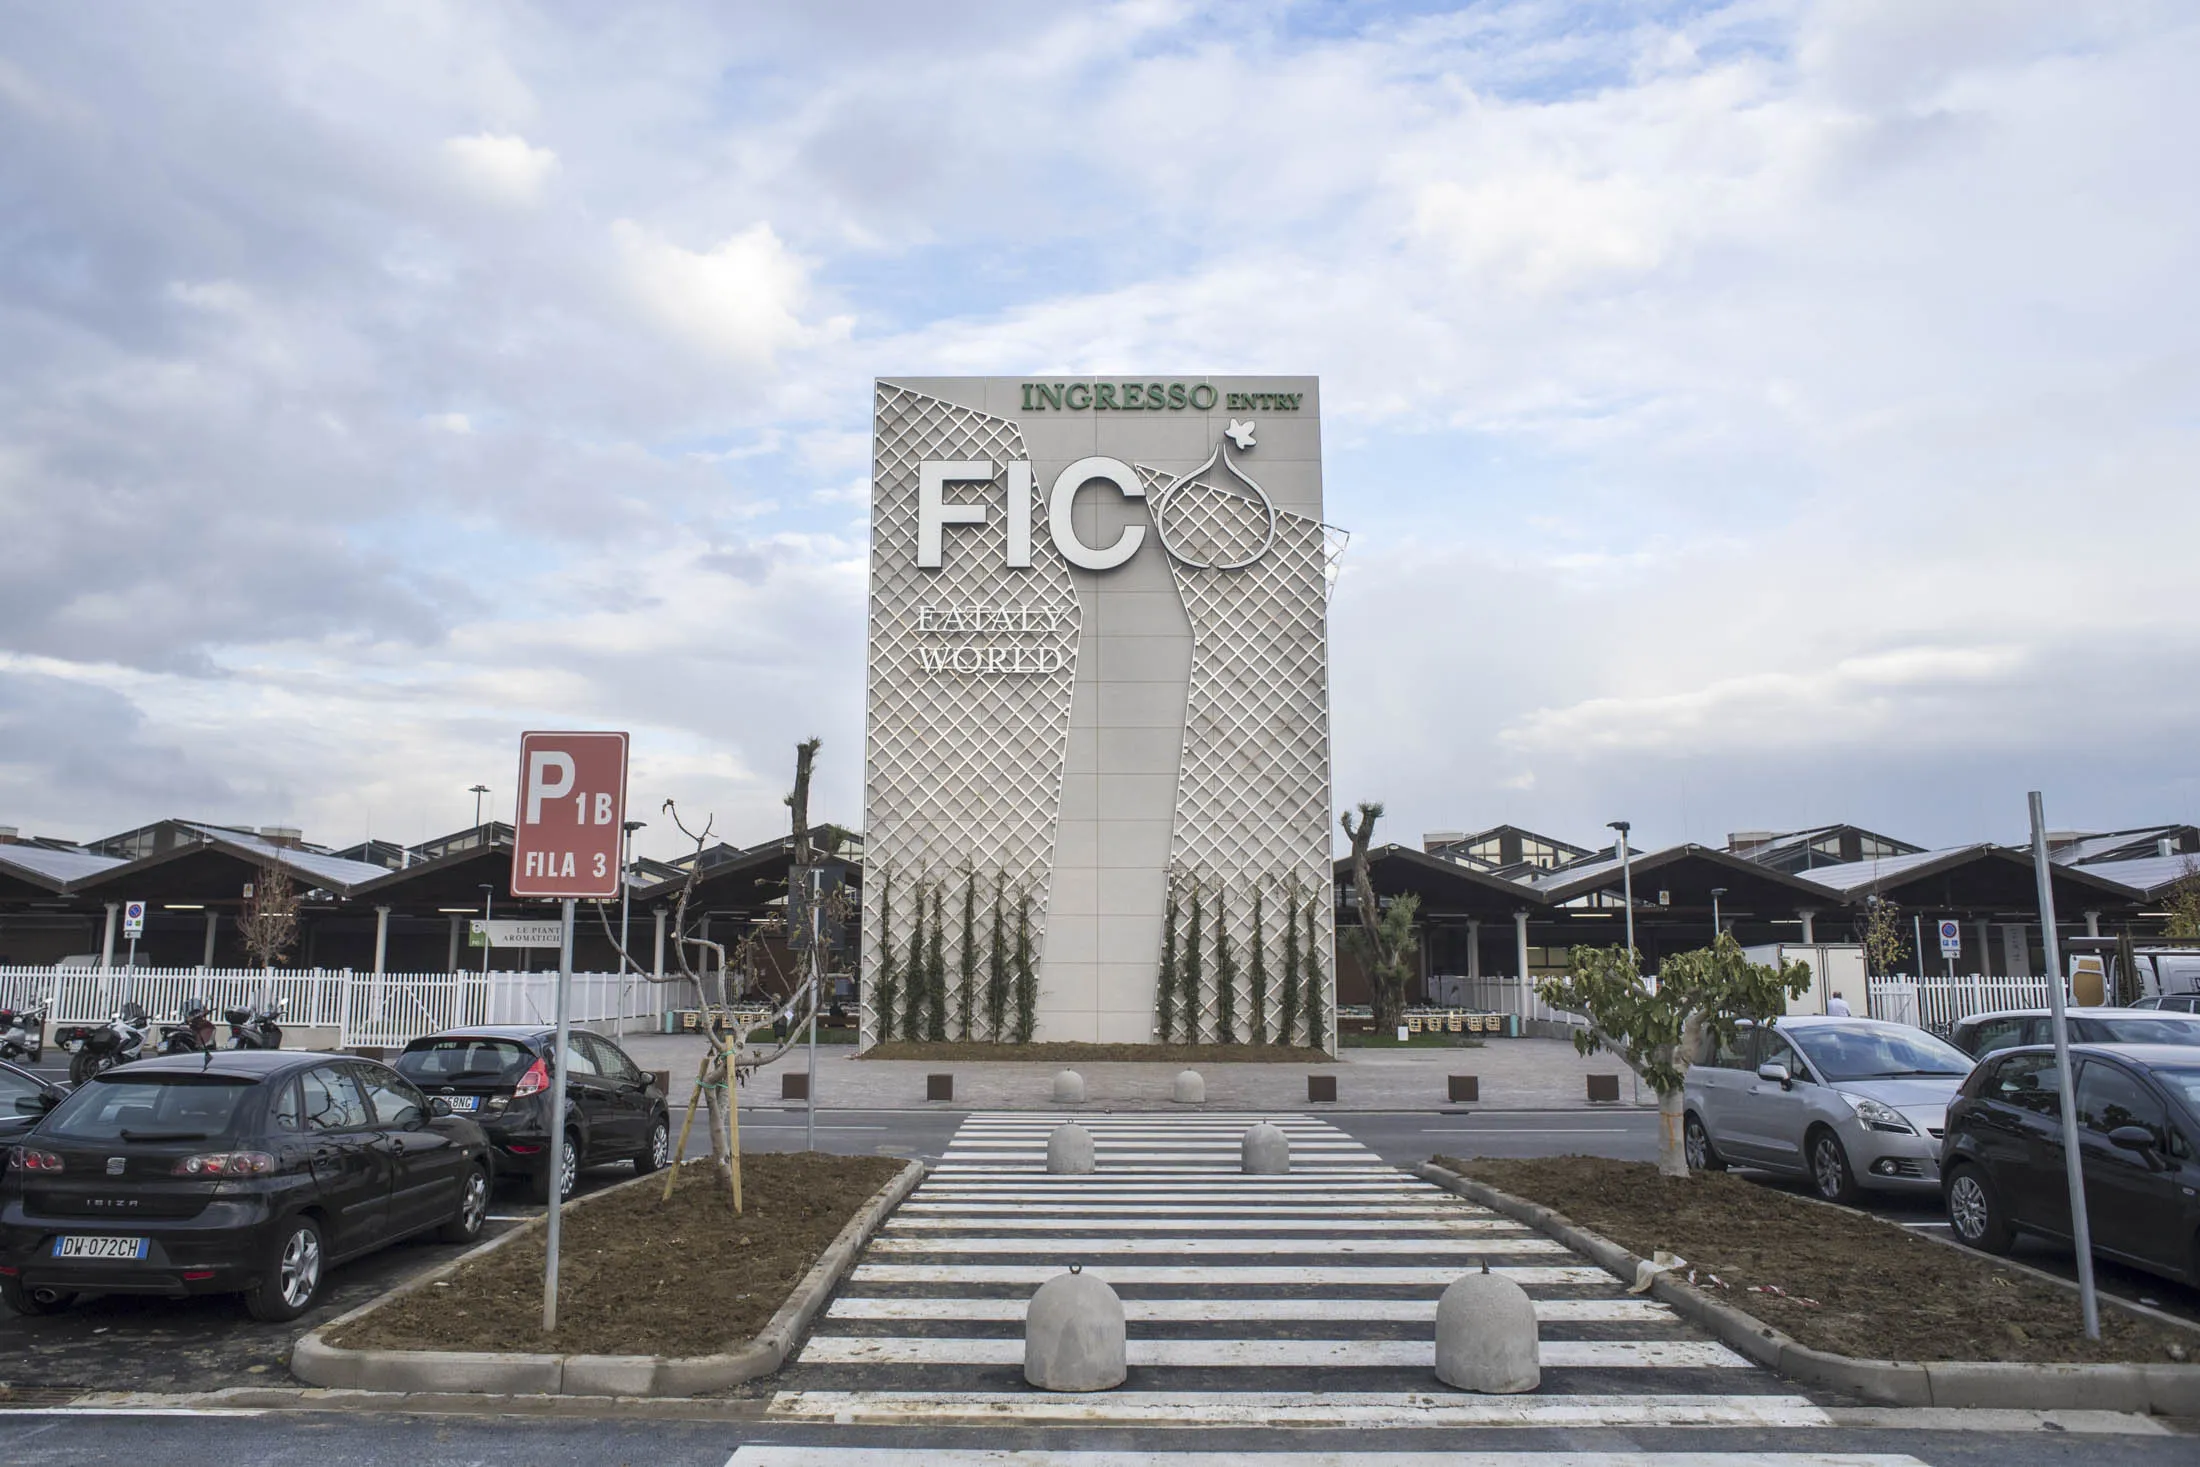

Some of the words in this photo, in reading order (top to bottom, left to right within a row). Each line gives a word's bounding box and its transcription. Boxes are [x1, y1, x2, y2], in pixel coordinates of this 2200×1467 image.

[1021, 382, 1218, 410] INGRESSO
[1226, 393, 1304, 411] ENTRY
[916, 605, 1069, 632] EATALY
[916, 646, 1063, 674] WORLD
[525, 750, 576, 825] P
[525, 851, 576, 877] FILA
[592, 852, 607, 878] 3
[86, 1199, 139, 1207] IBIZA
